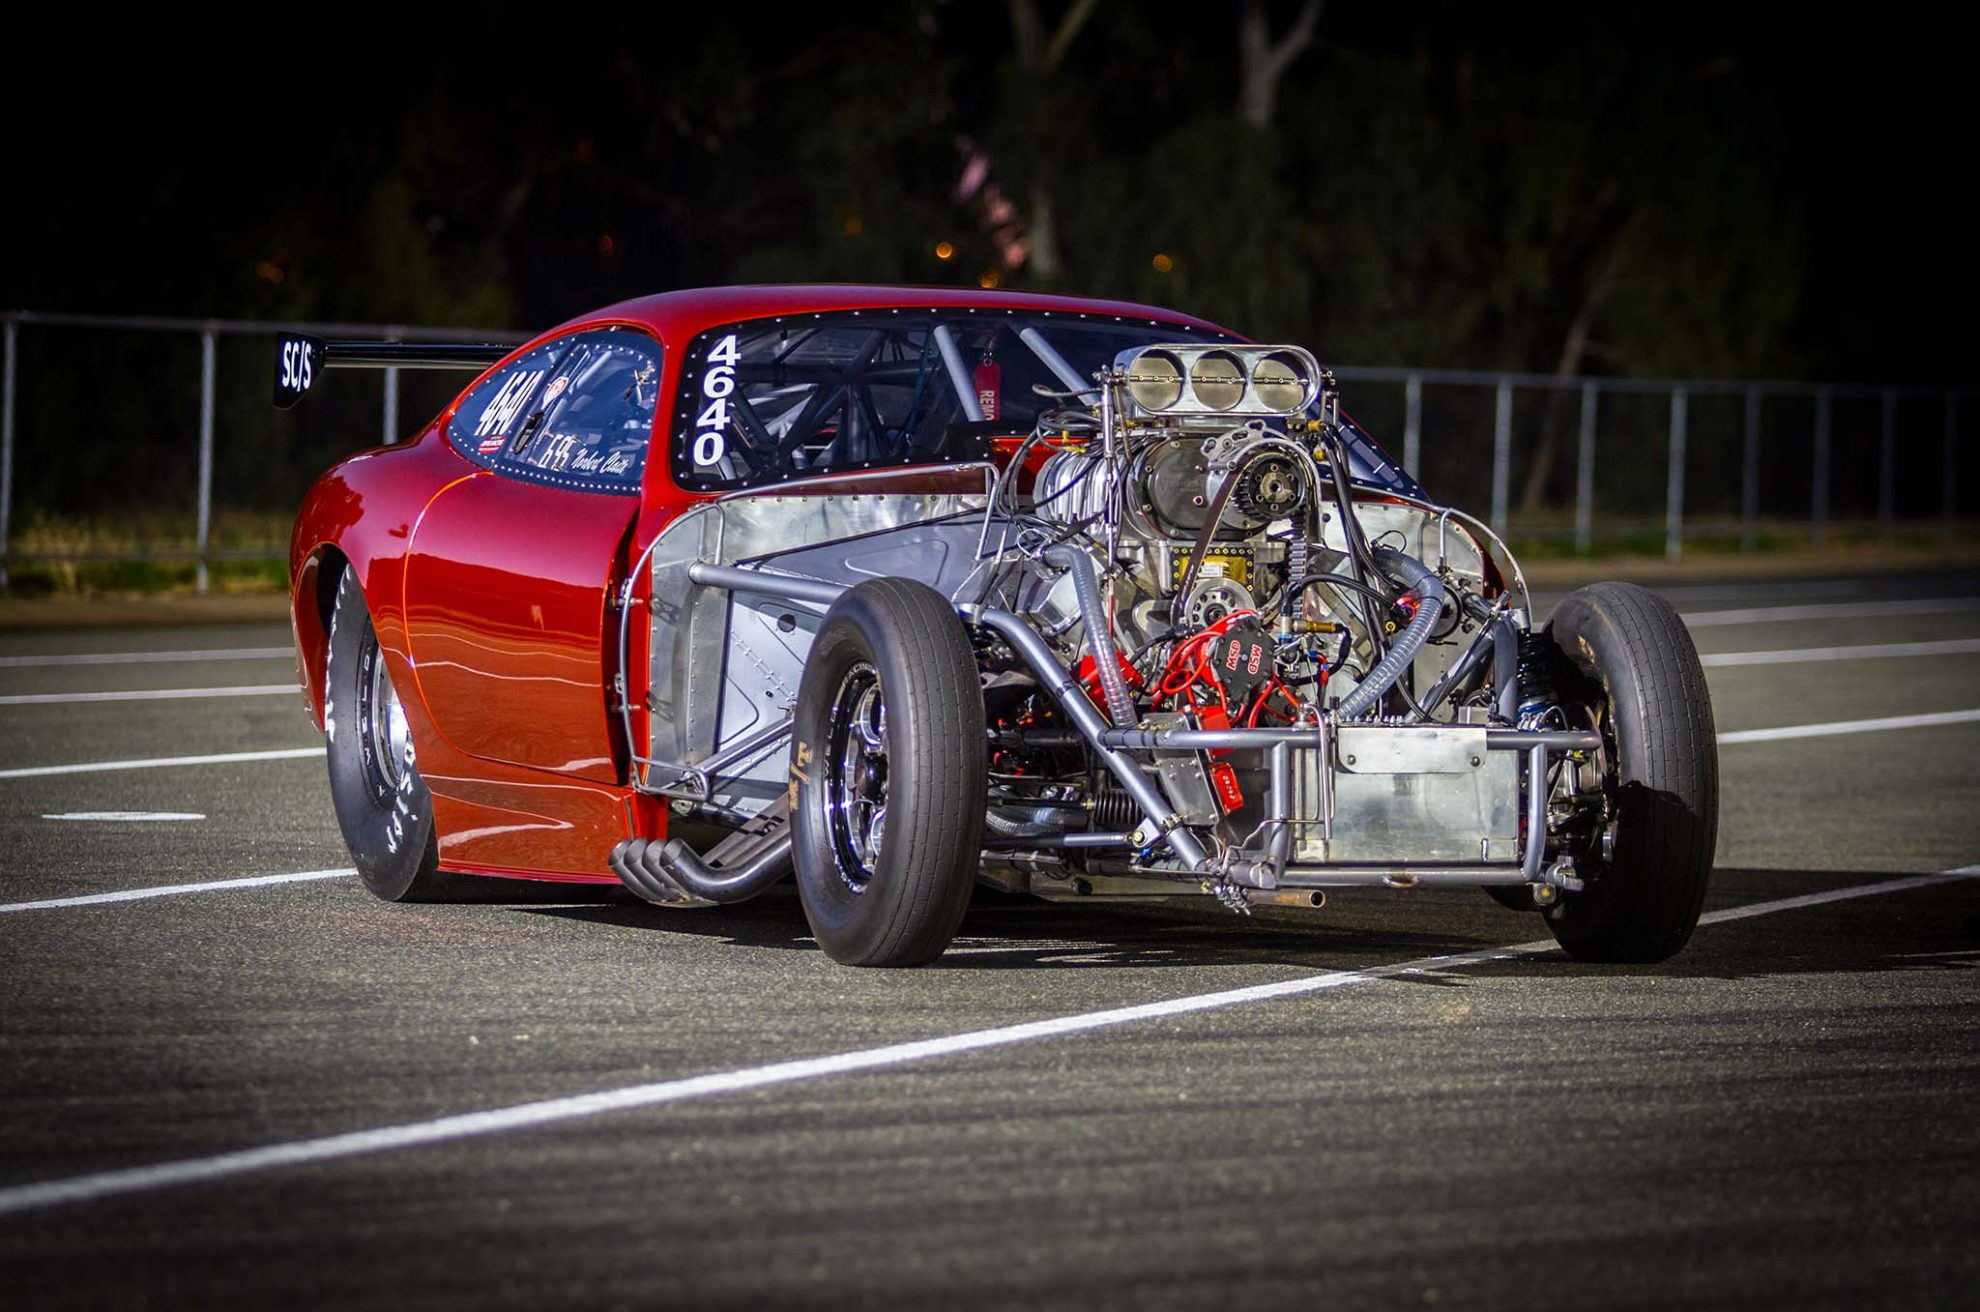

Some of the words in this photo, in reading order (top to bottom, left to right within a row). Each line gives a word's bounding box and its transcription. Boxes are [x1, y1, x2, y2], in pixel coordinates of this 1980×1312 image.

[282, 341, 312, 392] SC/S
[474, 370, 545, 436] 4640
[694, 335, 742, 466] 4640
[1226, 640, 1241, 671] MSD
[1247, 643, 1263, 675] MSD
[361, 654, 372, 767] WELD
